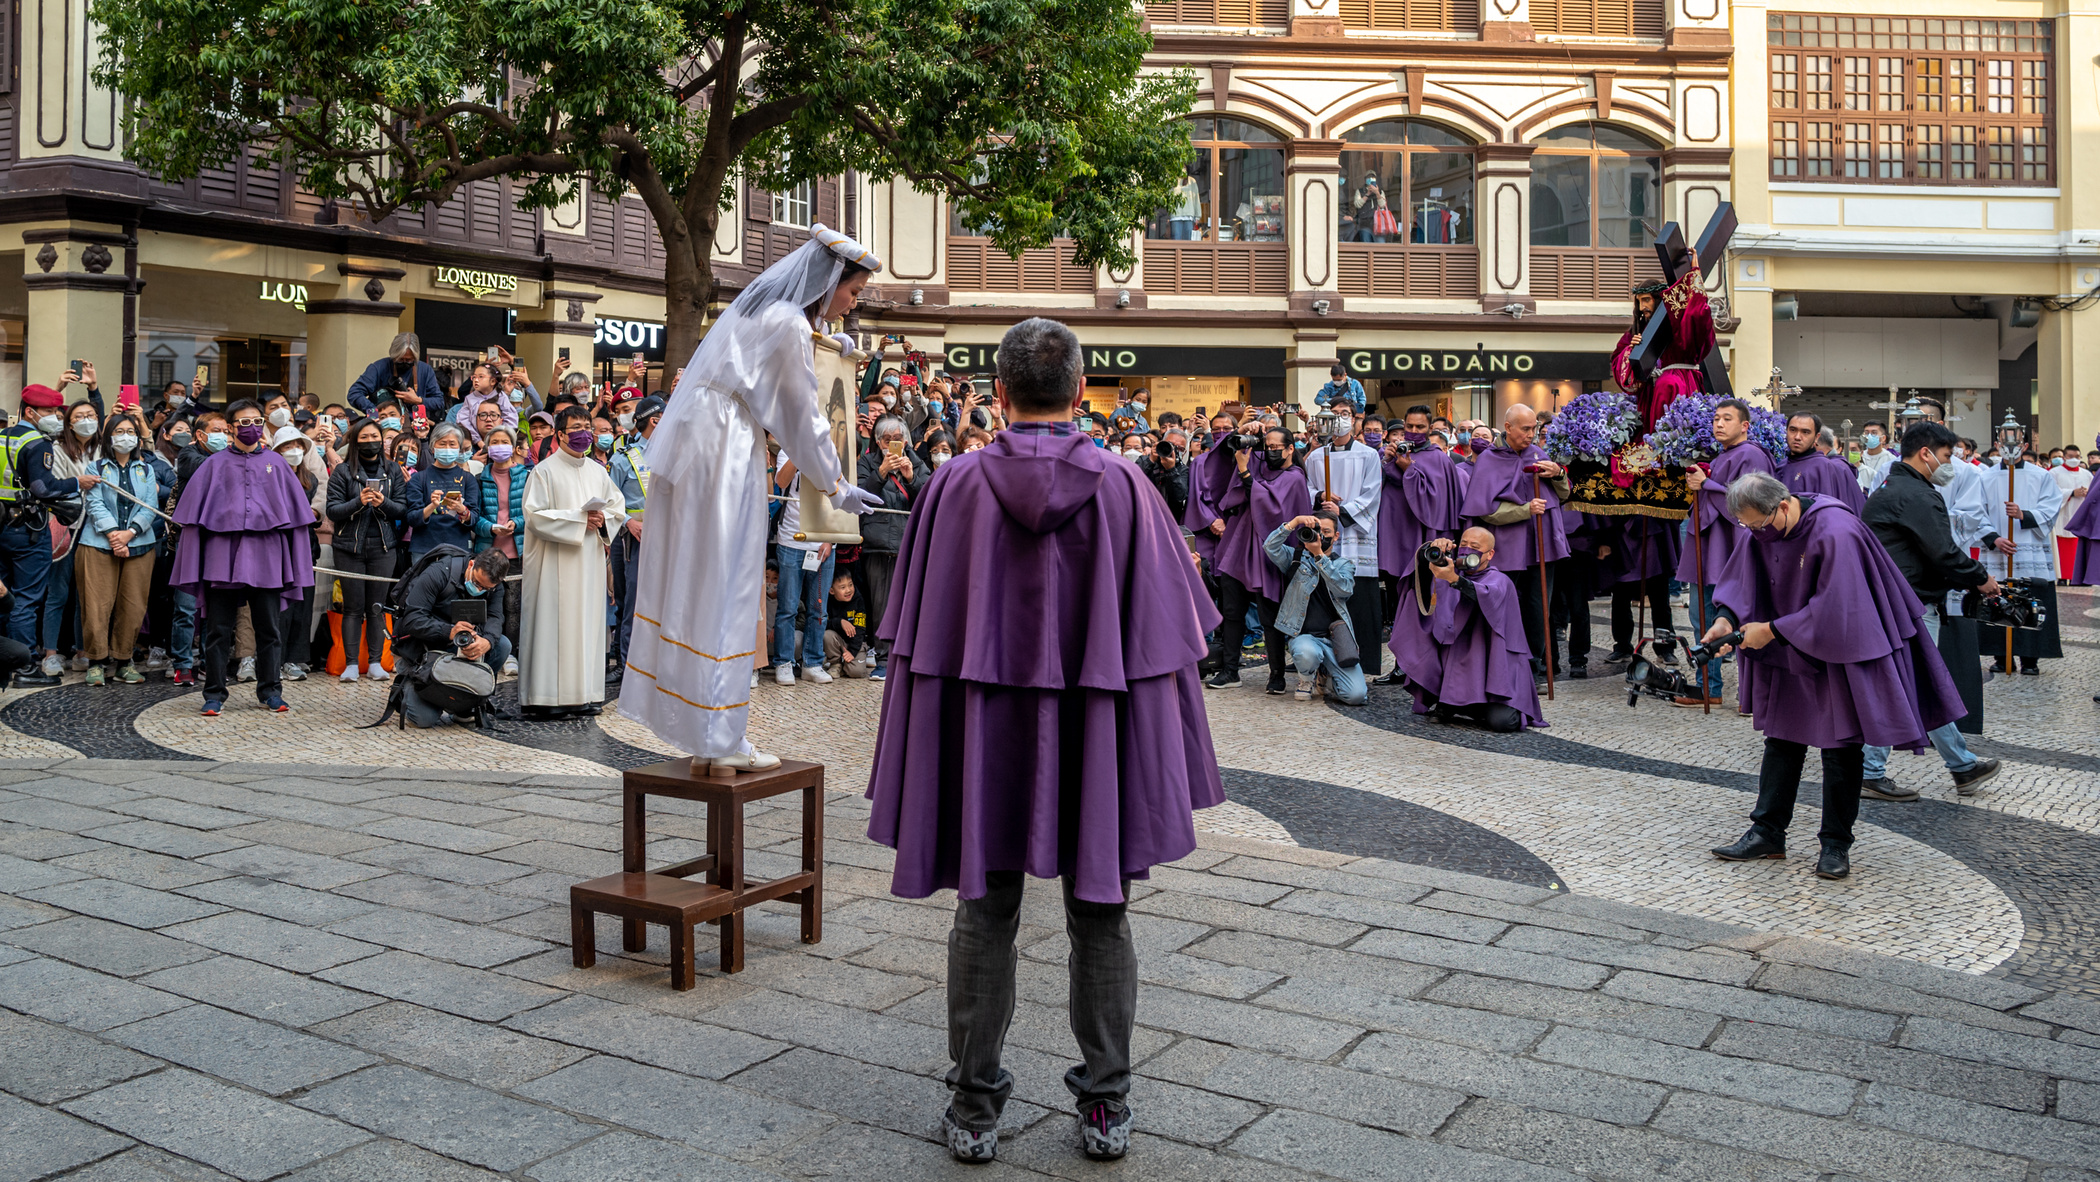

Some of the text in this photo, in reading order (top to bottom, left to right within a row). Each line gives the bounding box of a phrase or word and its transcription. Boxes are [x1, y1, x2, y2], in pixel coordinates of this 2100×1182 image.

[437, 266, 518, 291] LONGINES
[430, 356, 475, 371] TISSOT
[1350, 351, 1534, 372] GIORDANO
[1189, 384, 1228, 395] THANK YOU
